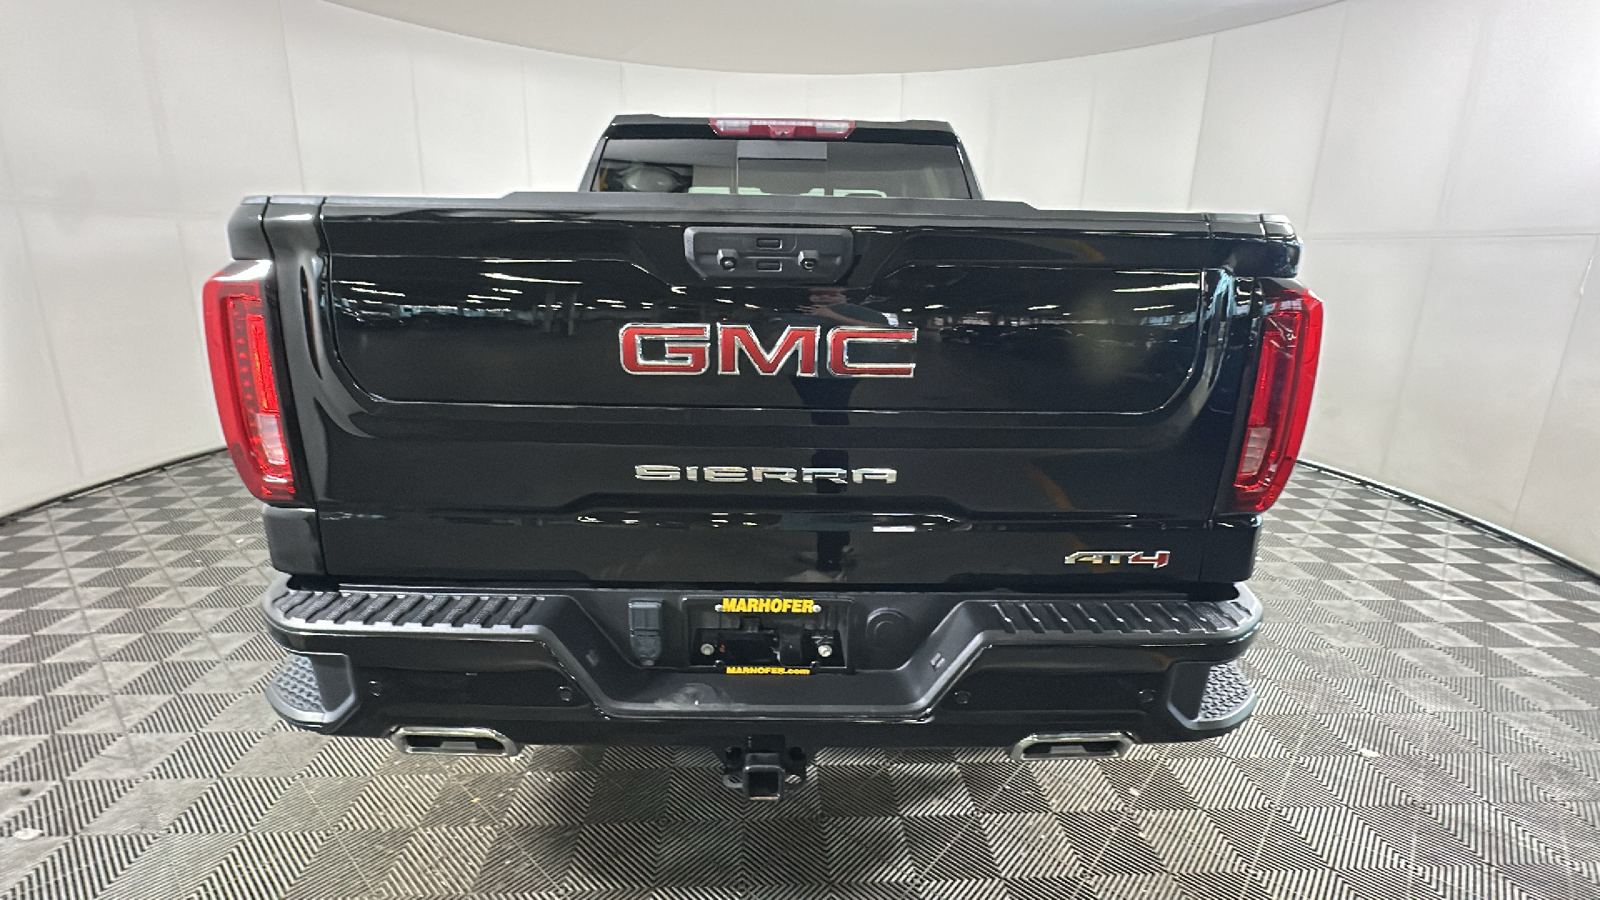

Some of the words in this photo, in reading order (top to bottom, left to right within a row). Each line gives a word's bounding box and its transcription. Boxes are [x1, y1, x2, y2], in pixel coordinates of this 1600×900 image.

[618, 322, 918, 378] GMC
[635, 464, 897, 484] SIERRA
[1064, 550, 1171, 569] AT4
[722, 597, 815, 613] MARHOFER
[726, 666, 810, 675] MARHOFER.com
